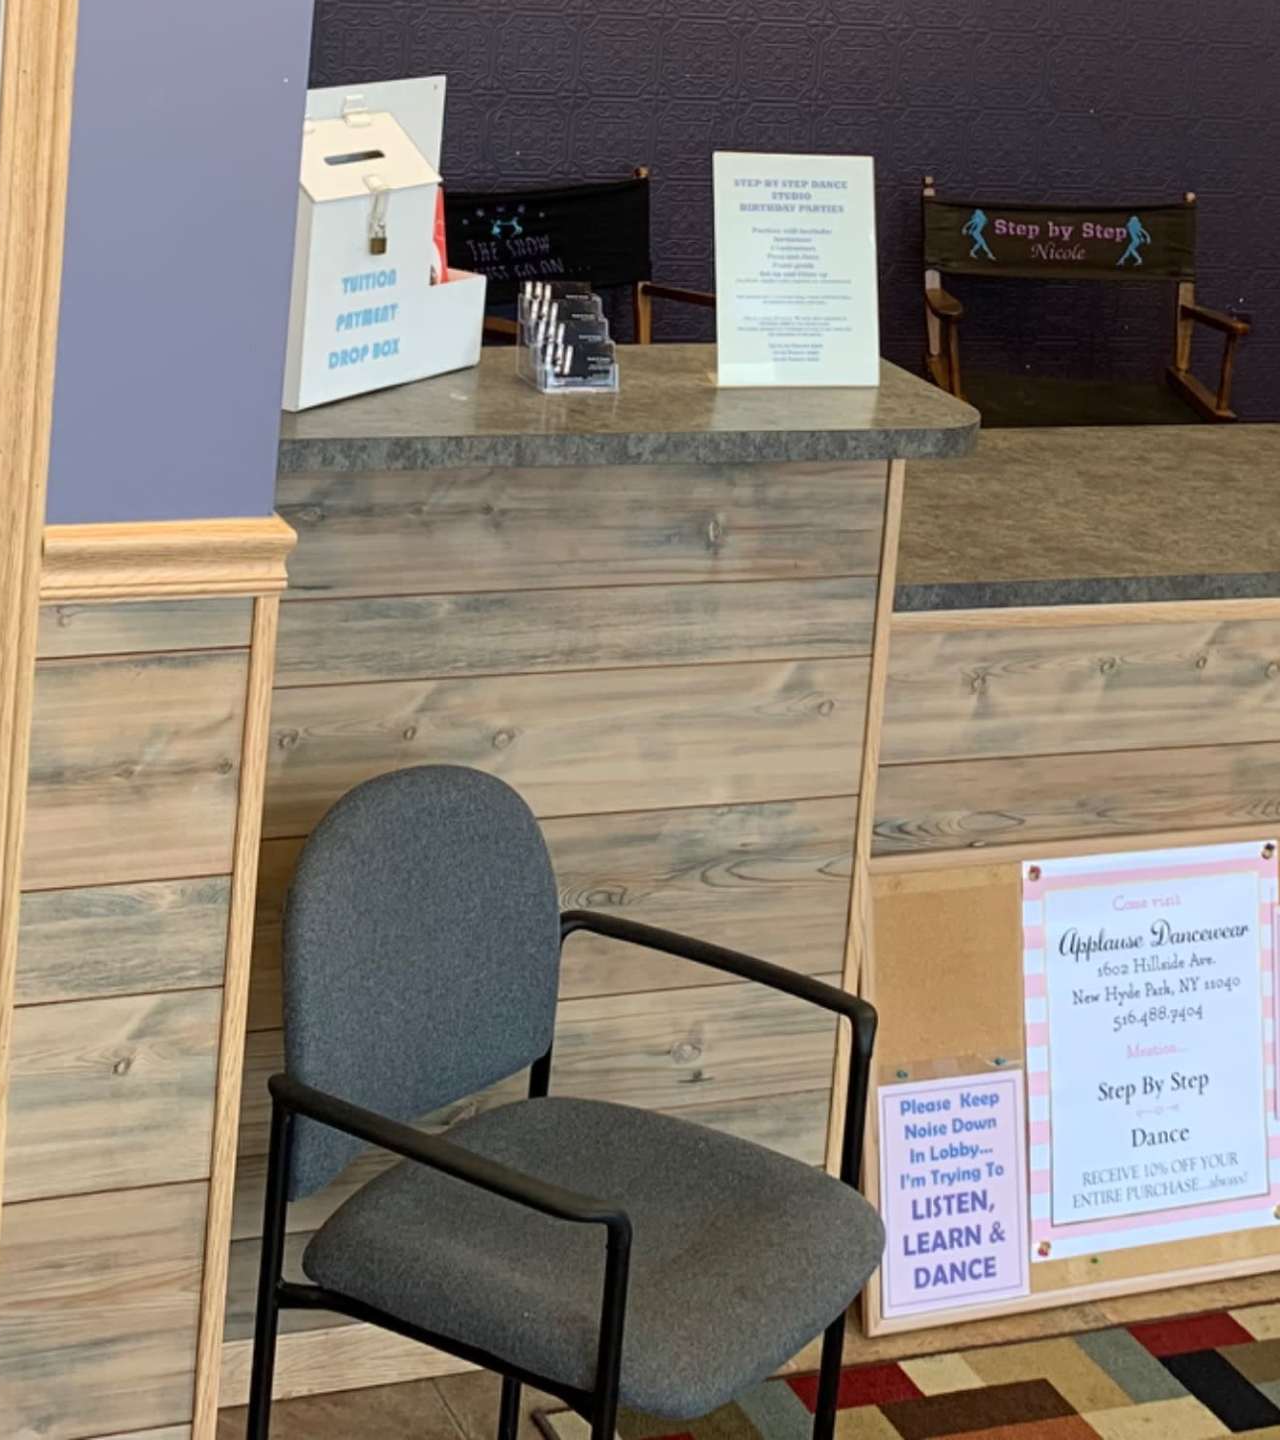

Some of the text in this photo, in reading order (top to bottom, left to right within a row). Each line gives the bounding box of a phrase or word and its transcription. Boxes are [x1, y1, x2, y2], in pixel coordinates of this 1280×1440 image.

[994, 219, 1128, 242] Step by Step
[1031, 241, 1087, 260] Nicole
[342, 269, 397, 294] TUITION
[336, 303, 399, 332] PAYMENT
[328, 338, 400, 369] DROP BOX
[1058, 918, 1250, 963] Applause Dancewear
[1097, 952, 1216, 978] 1602 Hillside Ave.
[1072, 976, 1241, 1006] New Hyde Park, NY 11040
[1097, 1072, 1209, 1105] Step By Step
[900, 1092, 1000, 1116] Please Keep
[904, 1117, 997, 1140] Noise Down
[1131, 1127, 1190, 1148] Dance
[910, 1142, 993, 1164] In Lobby...
[900, 1162, 1004, 1190] I'm Trying To
[1081, 1165, 1140, 1188] RECEIVE
[1170, 1156, 1198, 1175] OFF
[1199, 1151, 1240, 1171] YOUR
[912, 1189, 995, 1221] LISTEN,
[1072, 1188, 1123, 1209] ENTIRE
[903, 1221, 1006, 1256] LEARN &
[914, 1256, 997, 1290] DANCE
